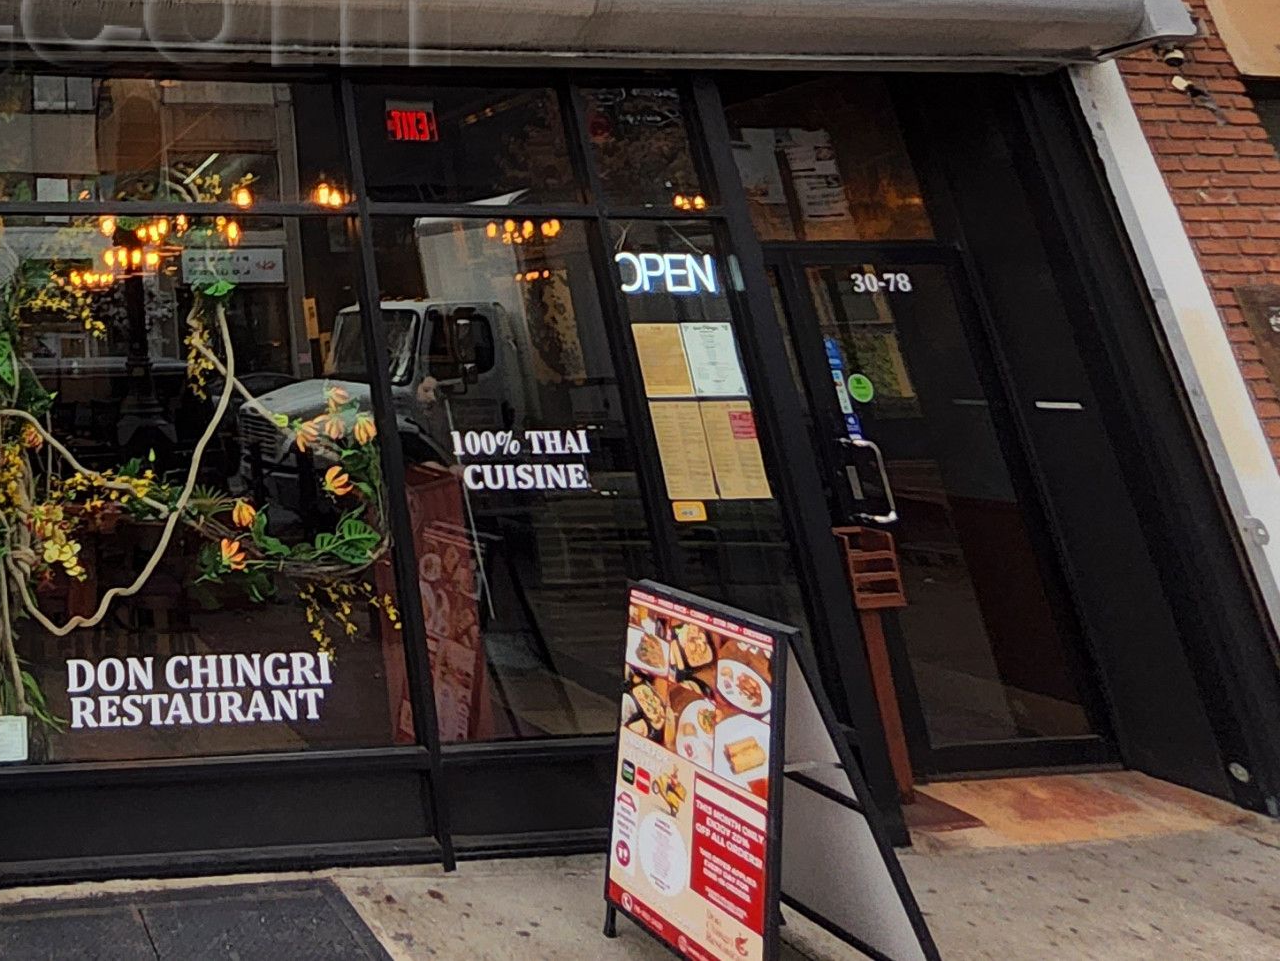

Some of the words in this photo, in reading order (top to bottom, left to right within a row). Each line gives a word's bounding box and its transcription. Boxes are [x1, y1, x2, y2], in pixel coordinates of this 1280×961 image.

[615, 252, 717, 293] OPEN
[850, 273, 913, 292] 30-78
[451, 431, 520, 456] 100%
[525, 430, 590, 455] THAI
[463, 465, 589, 490] CUISINE
[66, 656, 154, 693] DON
[165, 651, 332, 689] CHINGRI
[70, 688, 324, 729] RESTAURANT
